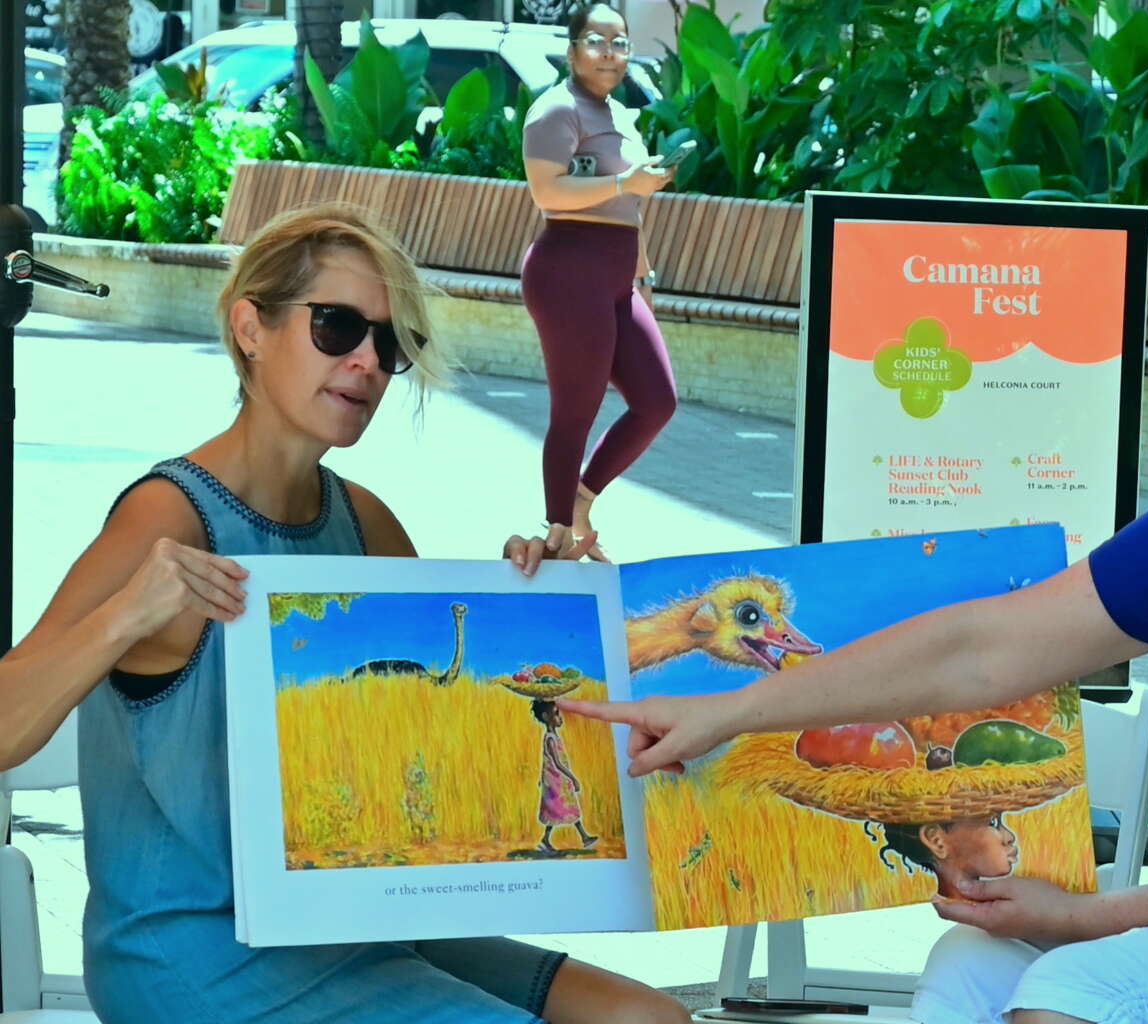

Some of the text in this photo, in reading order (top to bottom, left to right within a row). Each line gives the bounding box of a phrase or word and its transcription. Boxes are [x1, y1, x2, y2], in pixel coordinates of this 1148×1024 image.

[902, 254, 1041, 285] Camana
[973, 287, 1041, 316] Fest
[894, 359, 949, 370] CORNER
[892, 371, 952, 382] SCHEDULE
[983, 381, 1061, 390] HELCONIA COURT
[888, 455, 983, 470] LIFE & Rotary
[1027, 453, 1062, 465] Craft
[888, 469, 969, 481] Sunset Club
[1027, 466, 1076, 479] Corner
[888, 483, 982, 497] Reading Nook
[384, 878, 544, 896] or the sweet-smelling guava?
